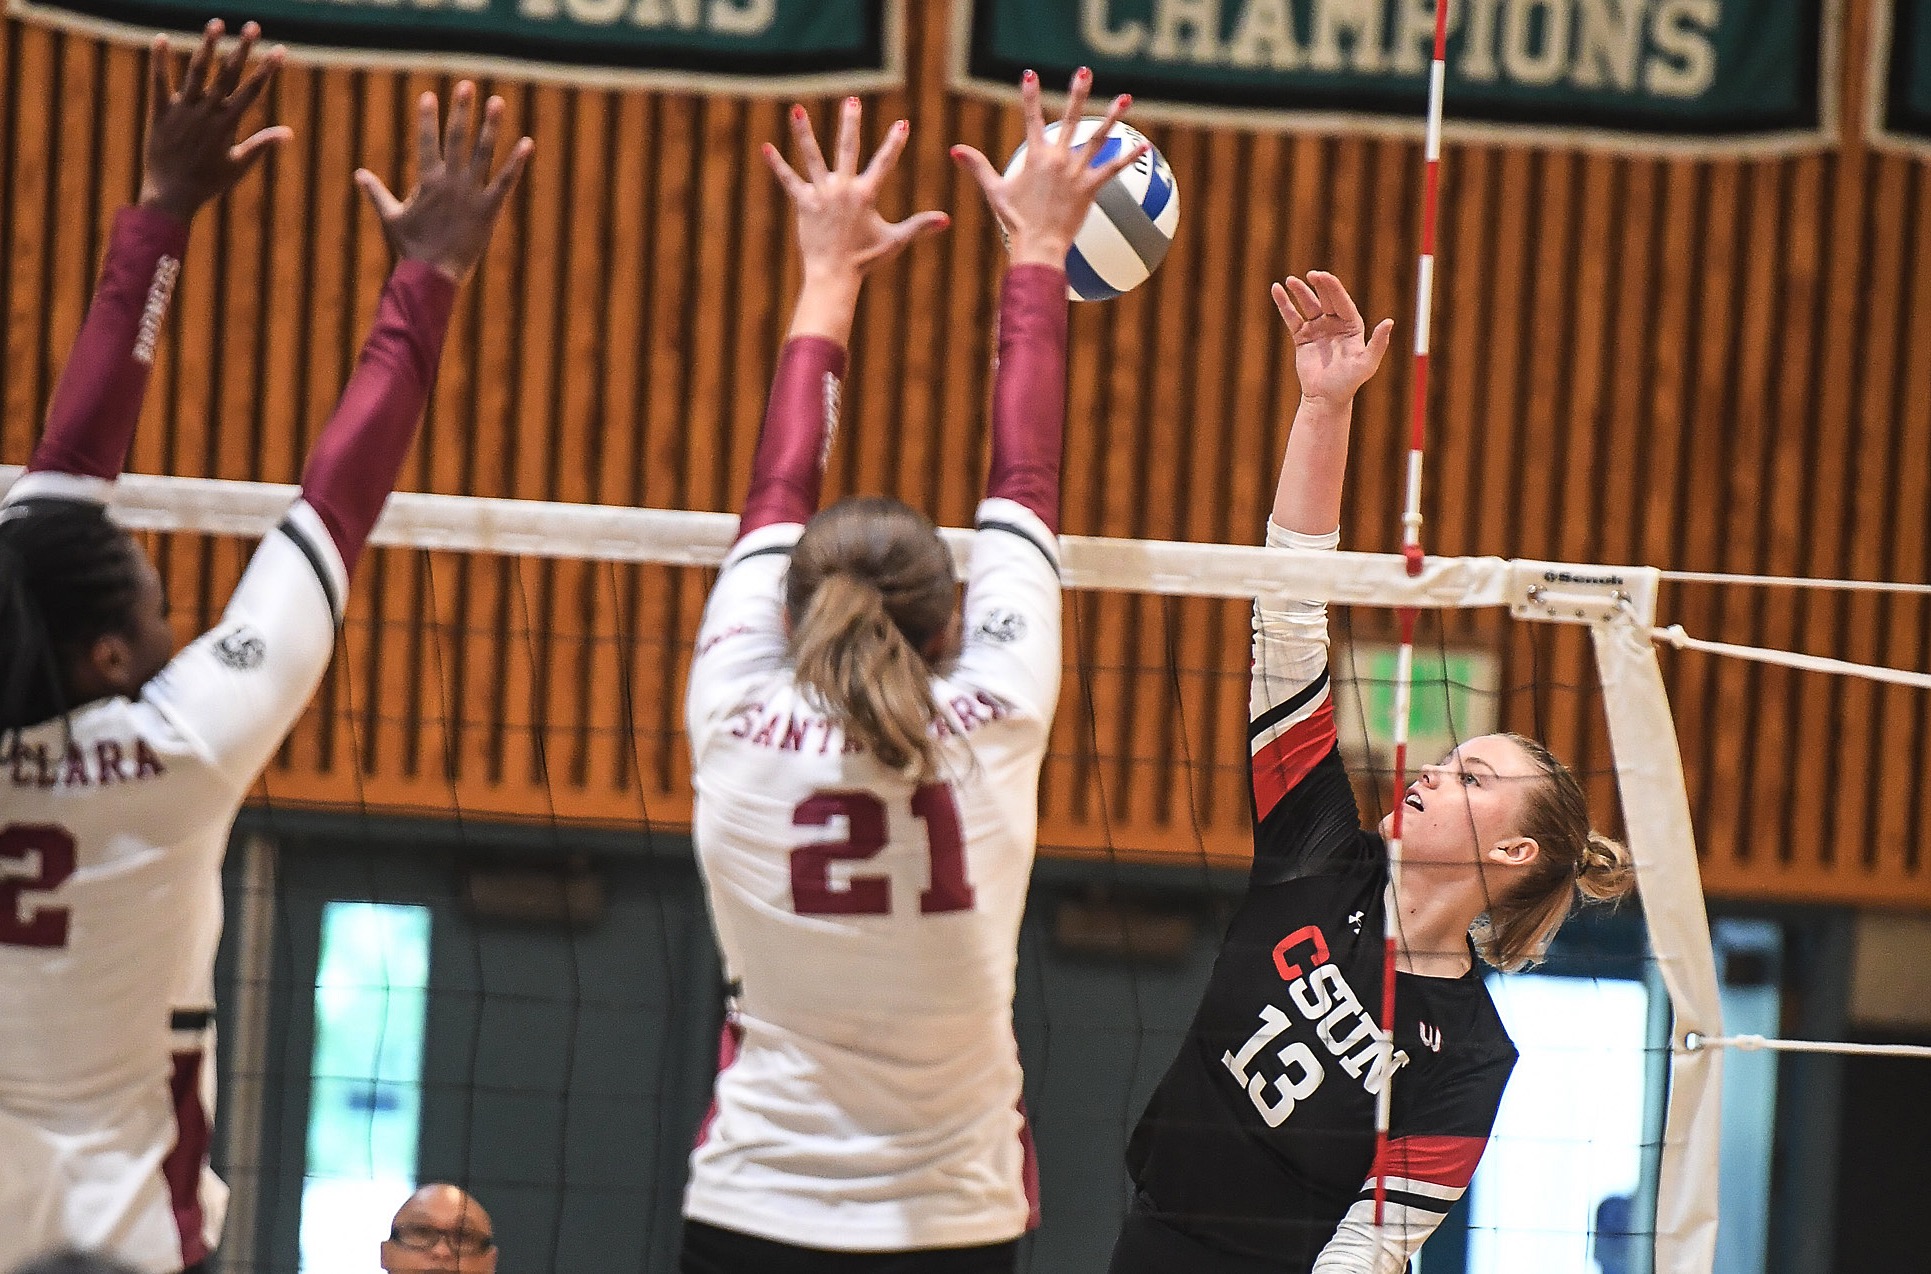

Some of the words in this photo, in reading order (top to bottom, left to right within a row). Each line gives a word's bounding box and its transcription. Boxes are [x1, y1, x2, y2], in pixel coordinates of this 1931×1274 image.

[1078, 0, 1720, 98] CHAMPIONS
[11, 737, 165, 787] CLARA
[789, 783, 975, 916] 21
[1220, 1004, 1325, 1128] 13
[1272, 925, 1410, 1095] CSUN
